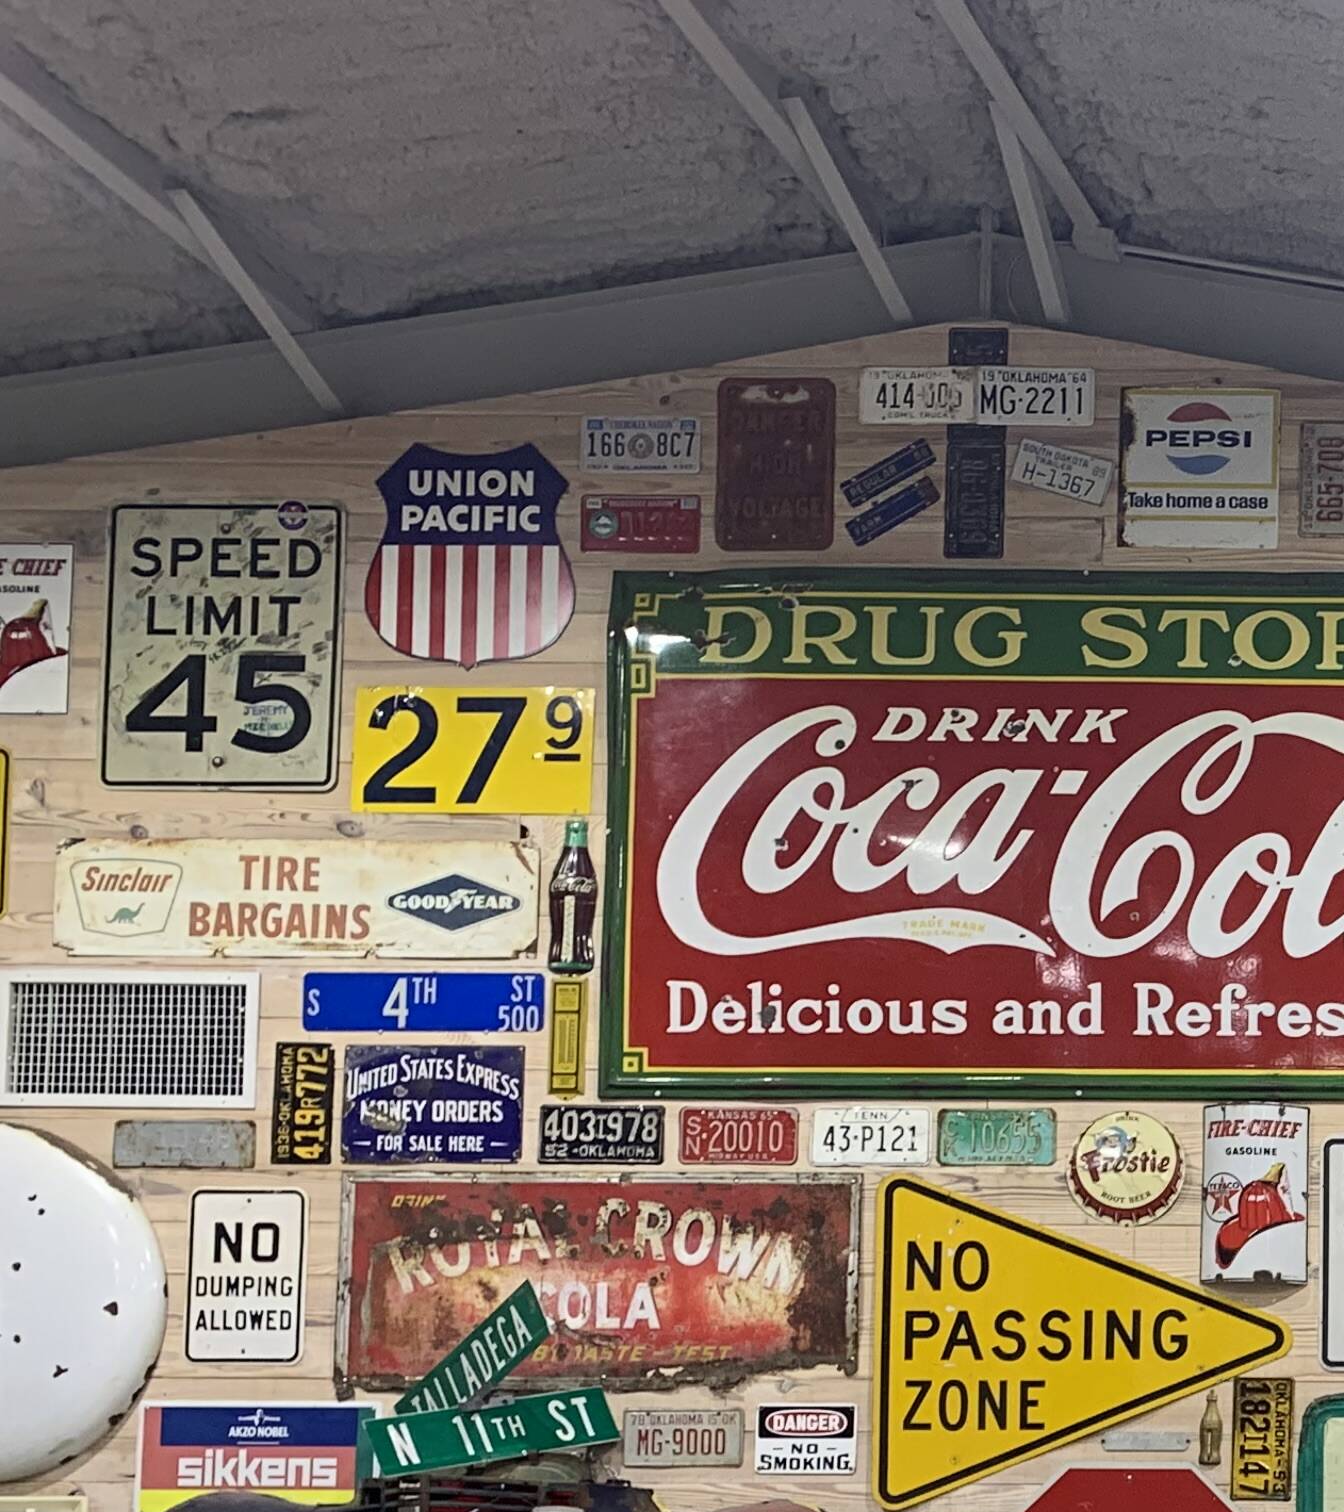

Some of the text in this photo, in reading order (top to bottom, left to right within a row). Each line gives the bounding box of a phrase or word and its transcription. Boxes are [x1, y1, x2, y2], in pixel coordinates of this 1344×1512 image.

[1001, 371, 1067, 383] OKLAHOMA
[587, 431, 626, 458] 166
[1146, 430, 1252, 448] PEPSI
[408, 468, 535, 498] UNION
[1127, 491, 1268, 510] Take home a case
[400, 503, 542, 533] PACIFIC
[131, 538, 321, 579] SPEED
[146, 596, 300, 636] LIMIT
[699, 605, 1028, 668] DRUG
[124, 653, 312, 754] 45
[871, 706, 1129, 744] DRINK
[80, 866, 173, 895] Sinclair
[239, 855, 320, 892] TIRE
[188, 902, 371, 940] BARGAINS
[308, 975, 535, 1030] S 4TH ST
[498, 1004, 539, 1031] 500
[665, 980, 968, 1039] Delicious
[995, 984, 1104, 1039] and
[400, 1053, 520, 1100] STATES EXPRESS
[359, 1100, 503, 1124] MONEY ORDERS
[707, 1120, 784, 1154] 20010
[1207, 1118, 1302, 1139] FIRE-CHIEF
[377, 1136, 485, 1152] FOR SALE HERE
[1225, 1147, 1278, 1157] GASOLINE
[213, 1222, 280, 1263] NO
[598, 1198, 805, 1297] CROWN
[905, 1240, 989, 1293] NO
[196, 1276, 293, 1298] DUMPING
[195, 1309, 292, 1332] ALLOWED
[904, 1309, 1190, 1362] PASSING
[902, 1380, 1047, 1433] ZONE
[228, 1423, 289, 1437] AKZO NOBEL
[387, 1396, 596, 1466] N 11TH ST
[772, 1414, 840, 1433] DANGER
[637, 1428, 726, 1456] MG-9000
[791, 1443, 819, 1454] NO
[177, 1454, 337, 1487] sikkens
[759, 1454, 850, 1472] SMOKING
